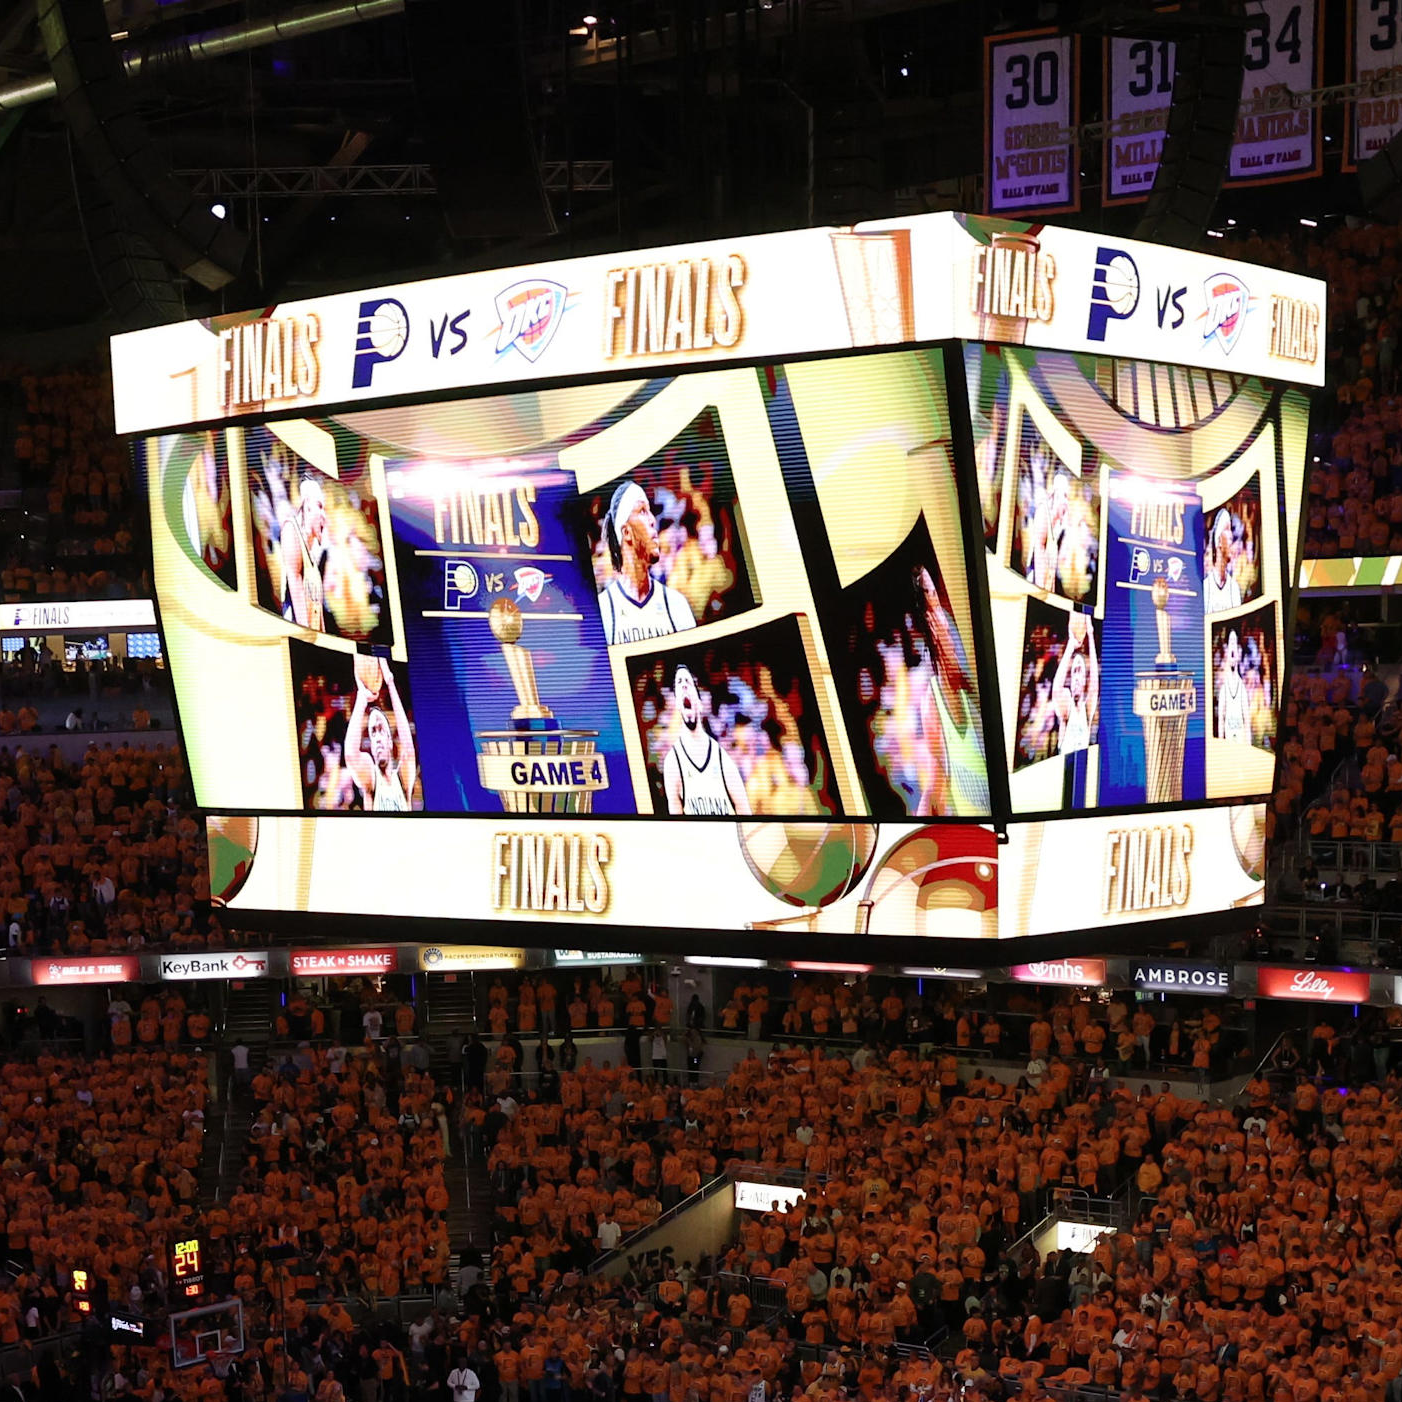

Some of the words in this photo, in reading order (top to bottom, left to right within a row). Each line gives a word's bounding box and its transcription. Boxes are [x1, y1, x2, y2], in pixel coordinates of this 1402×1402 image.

[1243, 5, 1302, 70] 34
[1005, 52, 1058, 108] 30
[1129, 41, 1172, 96] 31
[1115, 140, 1162, 168] MILL
[1240, 157, 1262, 168] HALL
[1264, 154, 1275, 164] OF
[1277, 150, 1301, 162] FAME
[1002, 188, 1023, 198] HALL
[1024, 186, 1034, 196] OF
[1035, 184, 1059, 195] FAME
[216, 313, 323, 407] FINALS
[430, 308, 471, 359] VS
[602, 254, 749, 361] FINALS
[1156, 283, 1188, 330] VS
[1269, 293, 1320, 365] FINALS
[434, 480, 540, 549] FINALS
[33, 607, 70, 625] FINALS
[1149, 691, 1186, 712] GAME
[510, 761, 587, 786] GAME
[590, 761, 603, 784] 4
[494, 833, 612, 914] FINALS
[1102, 822, 1194, 914] FINALS
[62, 966, 96, 976] BELLE
[97, 965, 123, 975] TIRE
[162, 960, 229, 976] KeyBank
[293, 956, 337, 968] STEAK
[347, 954, 392, 966] SHAKE
[1049, 961, 1084, 979] mhs
[1134, 968, 1230, 987] AMBROSE
[1290, 971, 1335, 999] Lilly
[174, 1251, 198, 1276] 24
